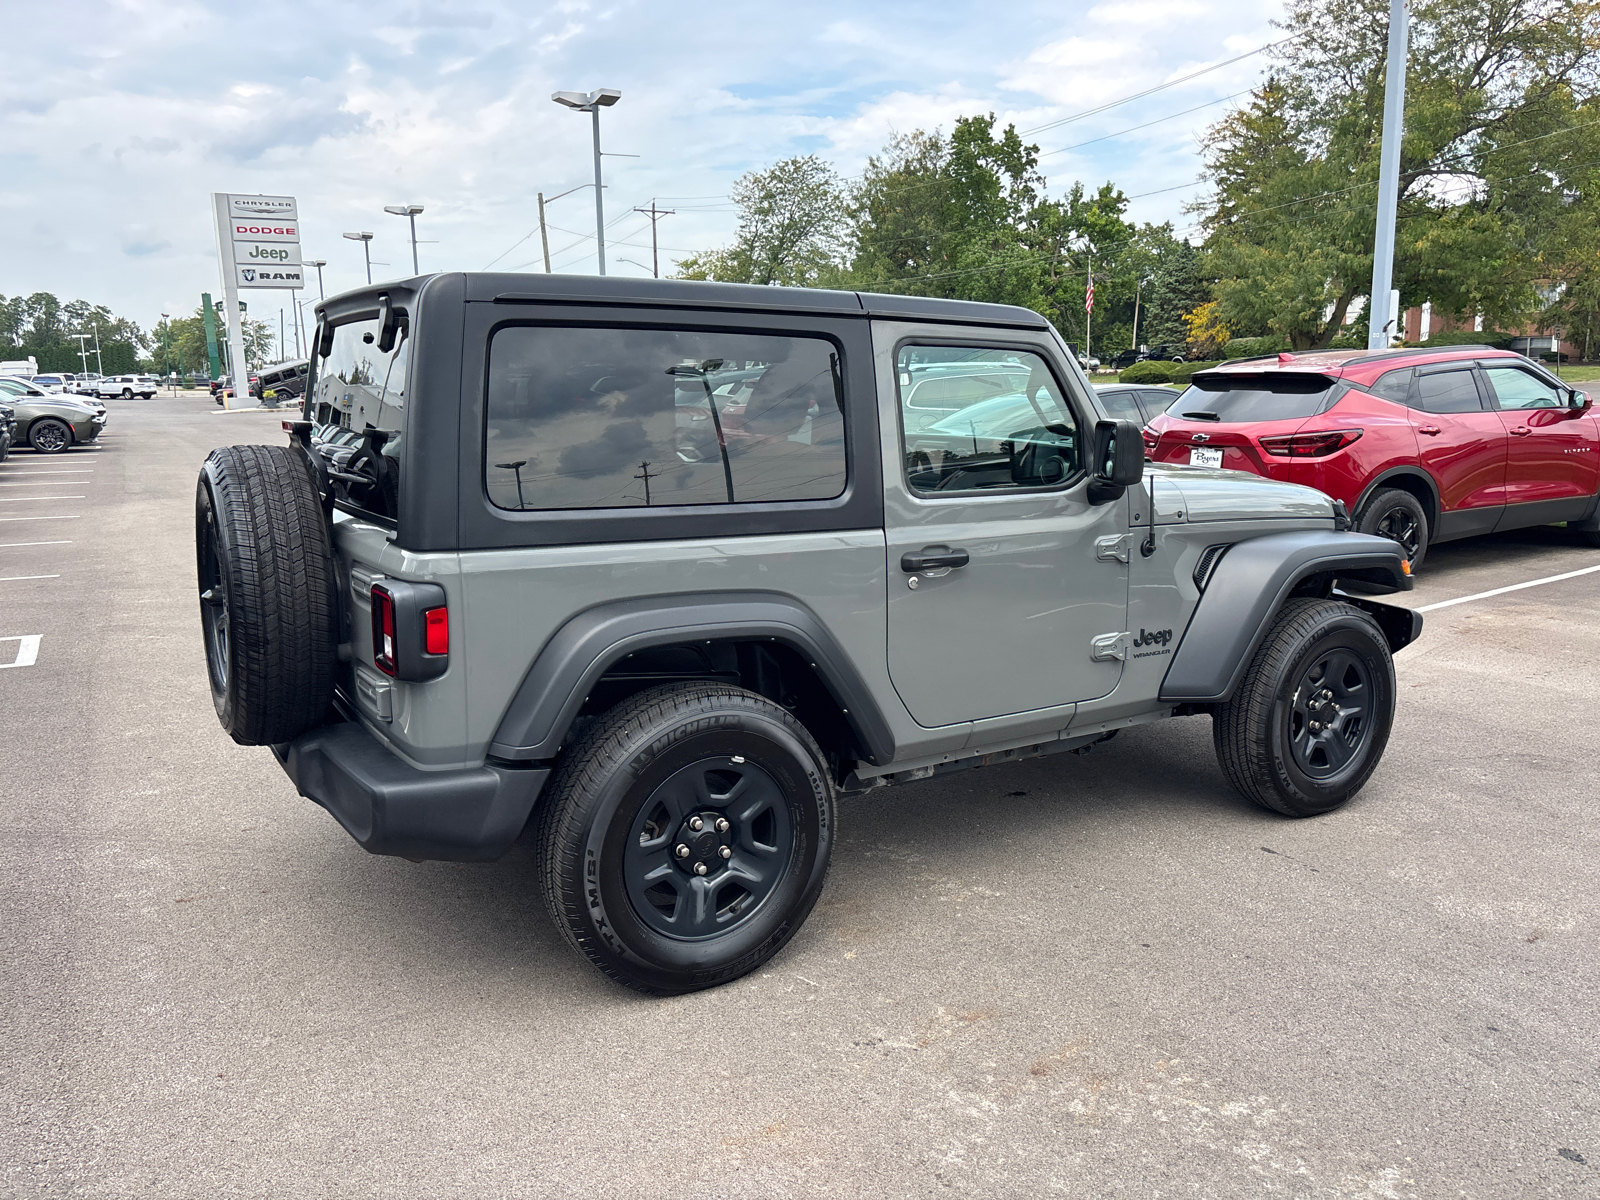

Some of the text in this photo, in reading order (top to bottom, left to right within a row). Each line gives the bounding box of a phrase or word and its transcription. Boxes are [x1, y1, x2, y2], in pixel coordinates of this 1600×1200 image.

[236, 226, 296, 235] DODGE
[249, 245, 289, 261] Jeep
[259, 272, 300, 280] RAM
[1133, 628, 1173, 648] Jeep
[1133, 649, 1171, 659] WRANGLER
[652, 715, 743, 757] MICHELIN
[595, 916, 627, 957] LTX
